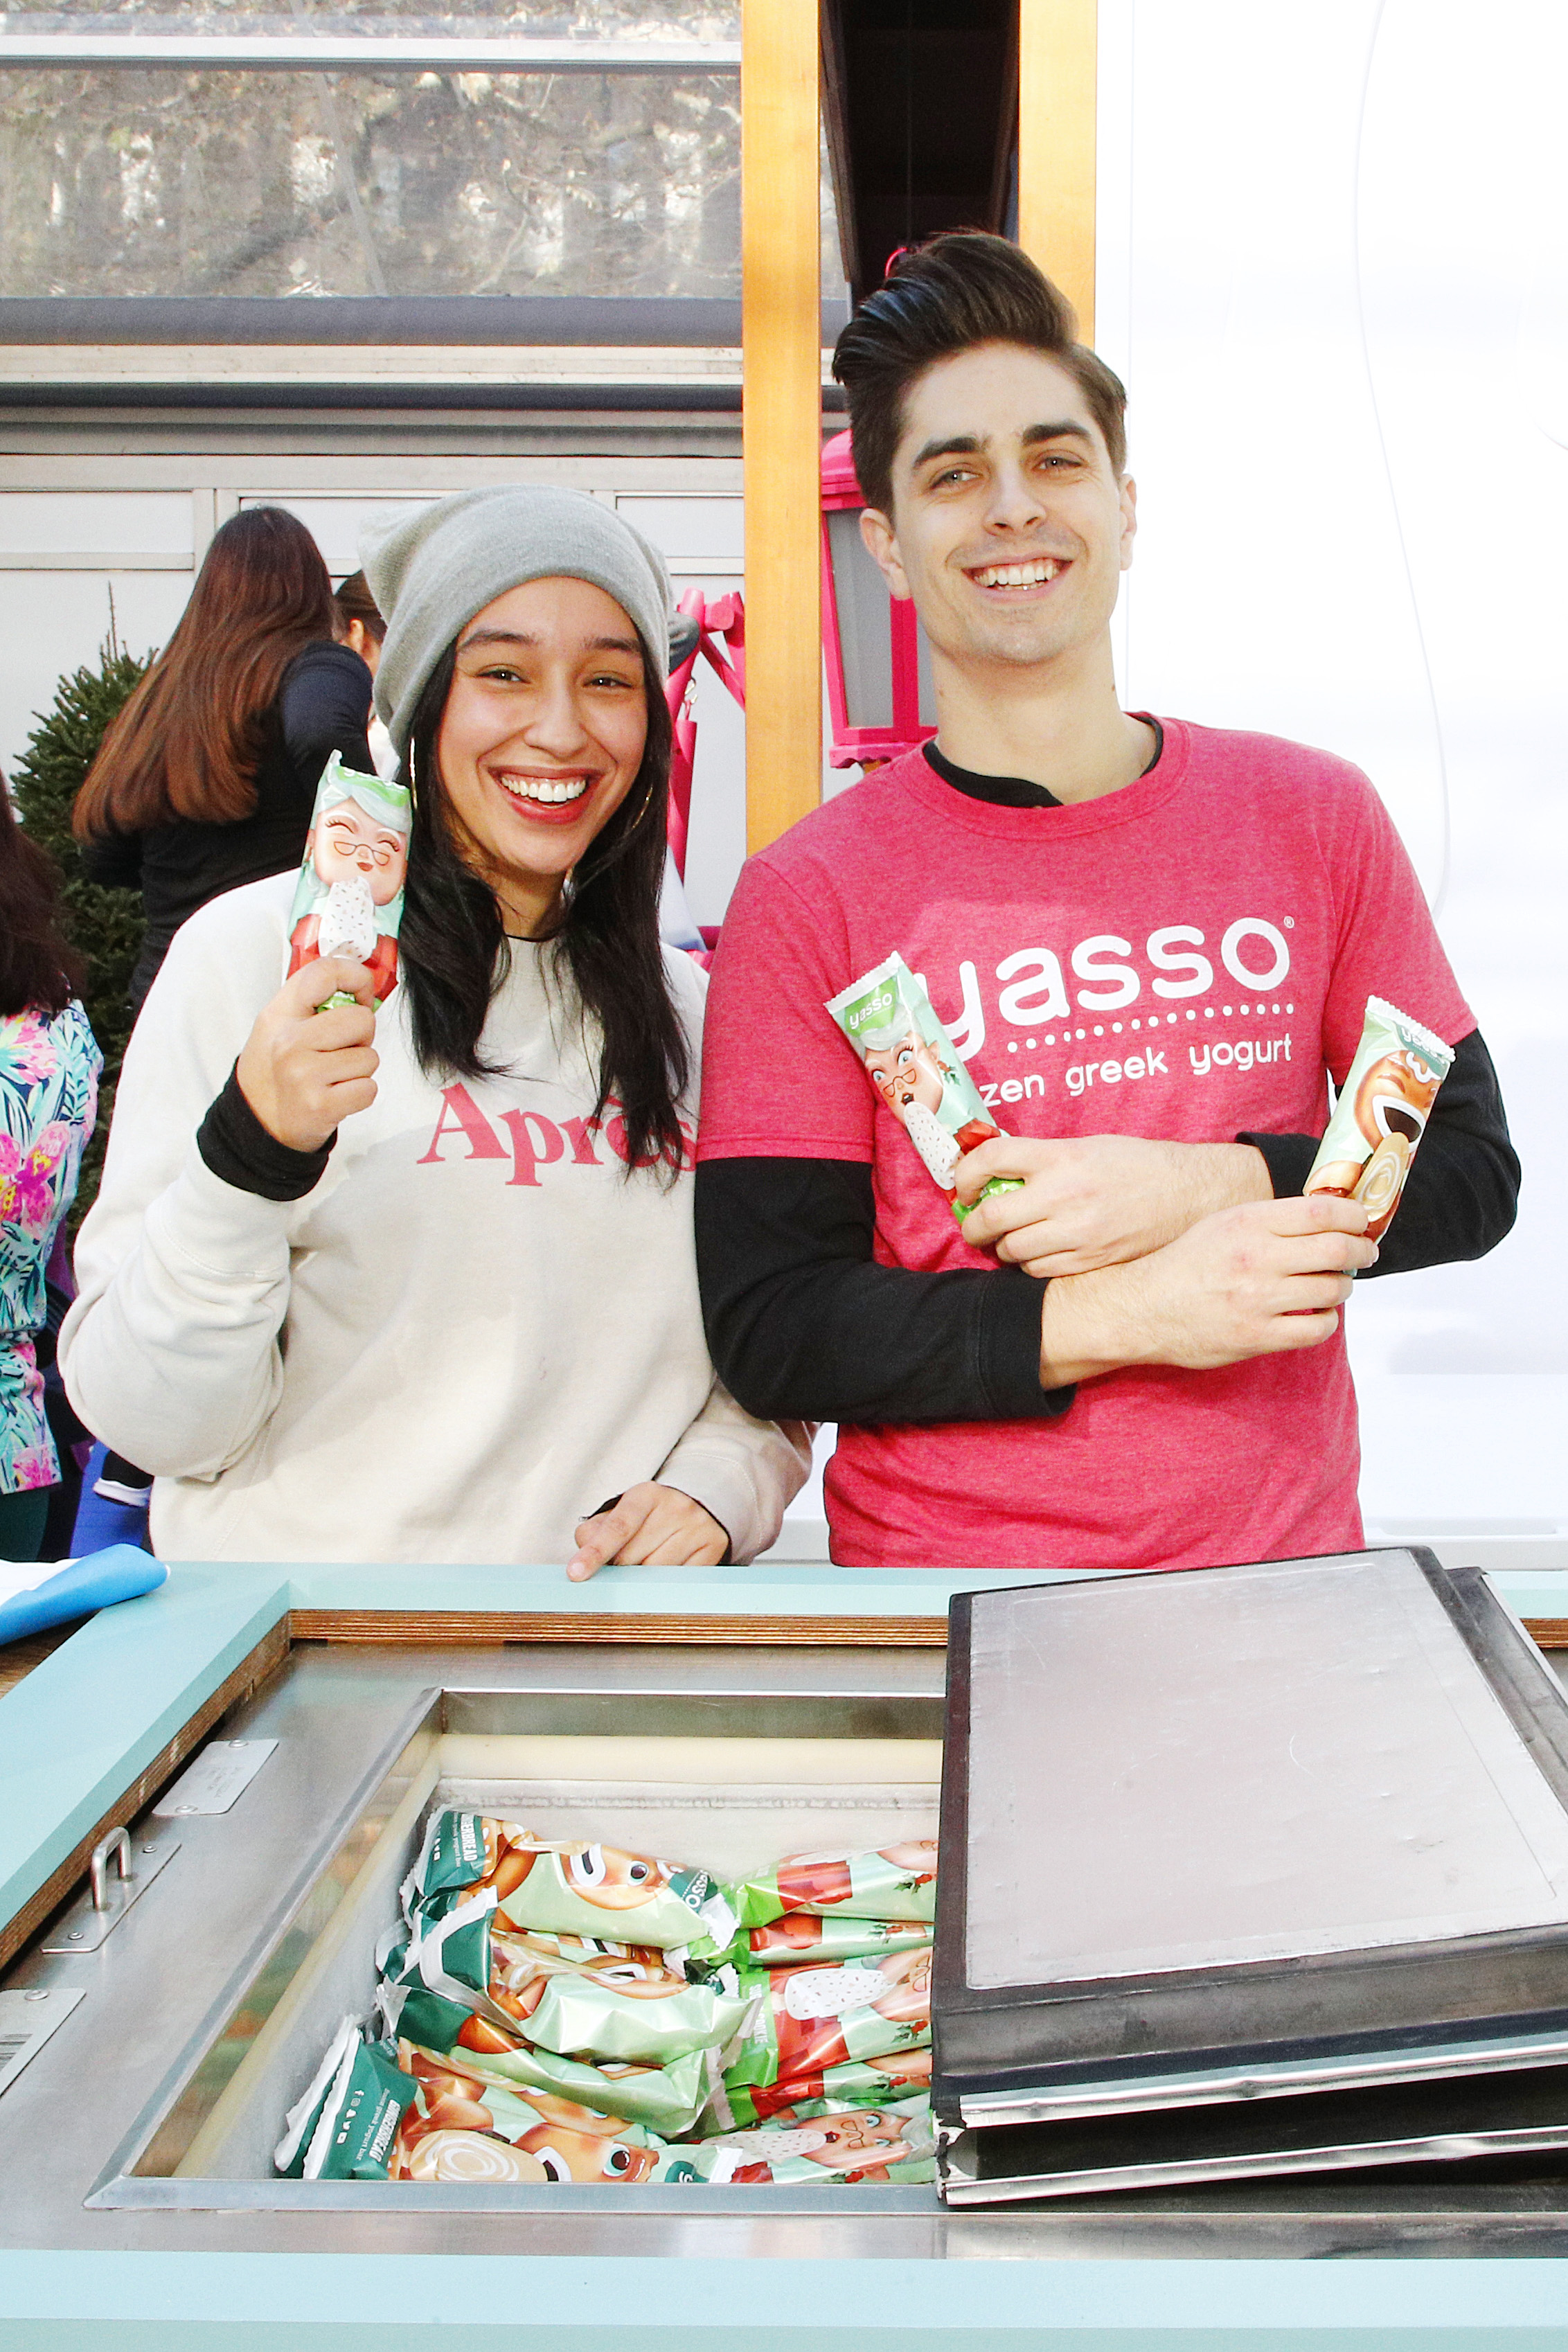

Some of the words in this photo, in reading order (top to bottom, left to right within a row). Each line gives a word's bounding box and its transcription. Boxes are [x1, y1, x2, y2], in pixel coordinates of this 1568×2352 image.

[849, 992, 893, 1030] yasso
[979, 1074, 1045, 1108] zen
[1066, 1046, 1168, 1096] greek
[1189, 1033, 1292, 1076] yogurt
